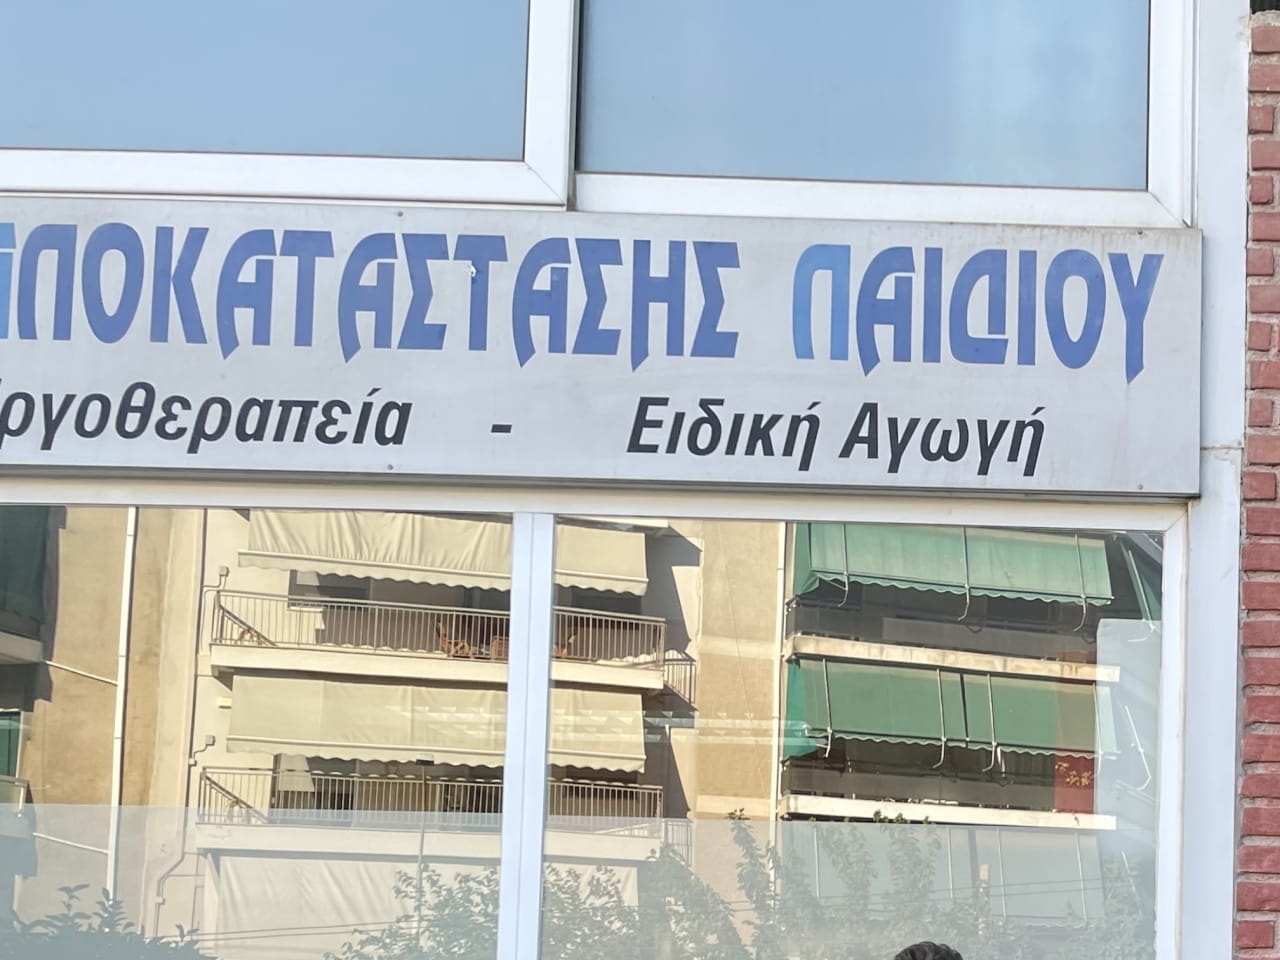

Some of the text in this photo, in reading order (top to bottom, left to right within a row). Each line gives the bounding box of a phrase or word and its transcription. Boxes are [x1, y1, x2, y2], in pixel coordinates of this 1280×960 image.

[0, 222, 1164, 385] ΠΟΚΑΤΑΣΤΑΣΗΣ ΠΑΙΔΙΟΥ
[0, 379, 1046, 477] ργοθεραπεία - Ειδική Αγωγή
